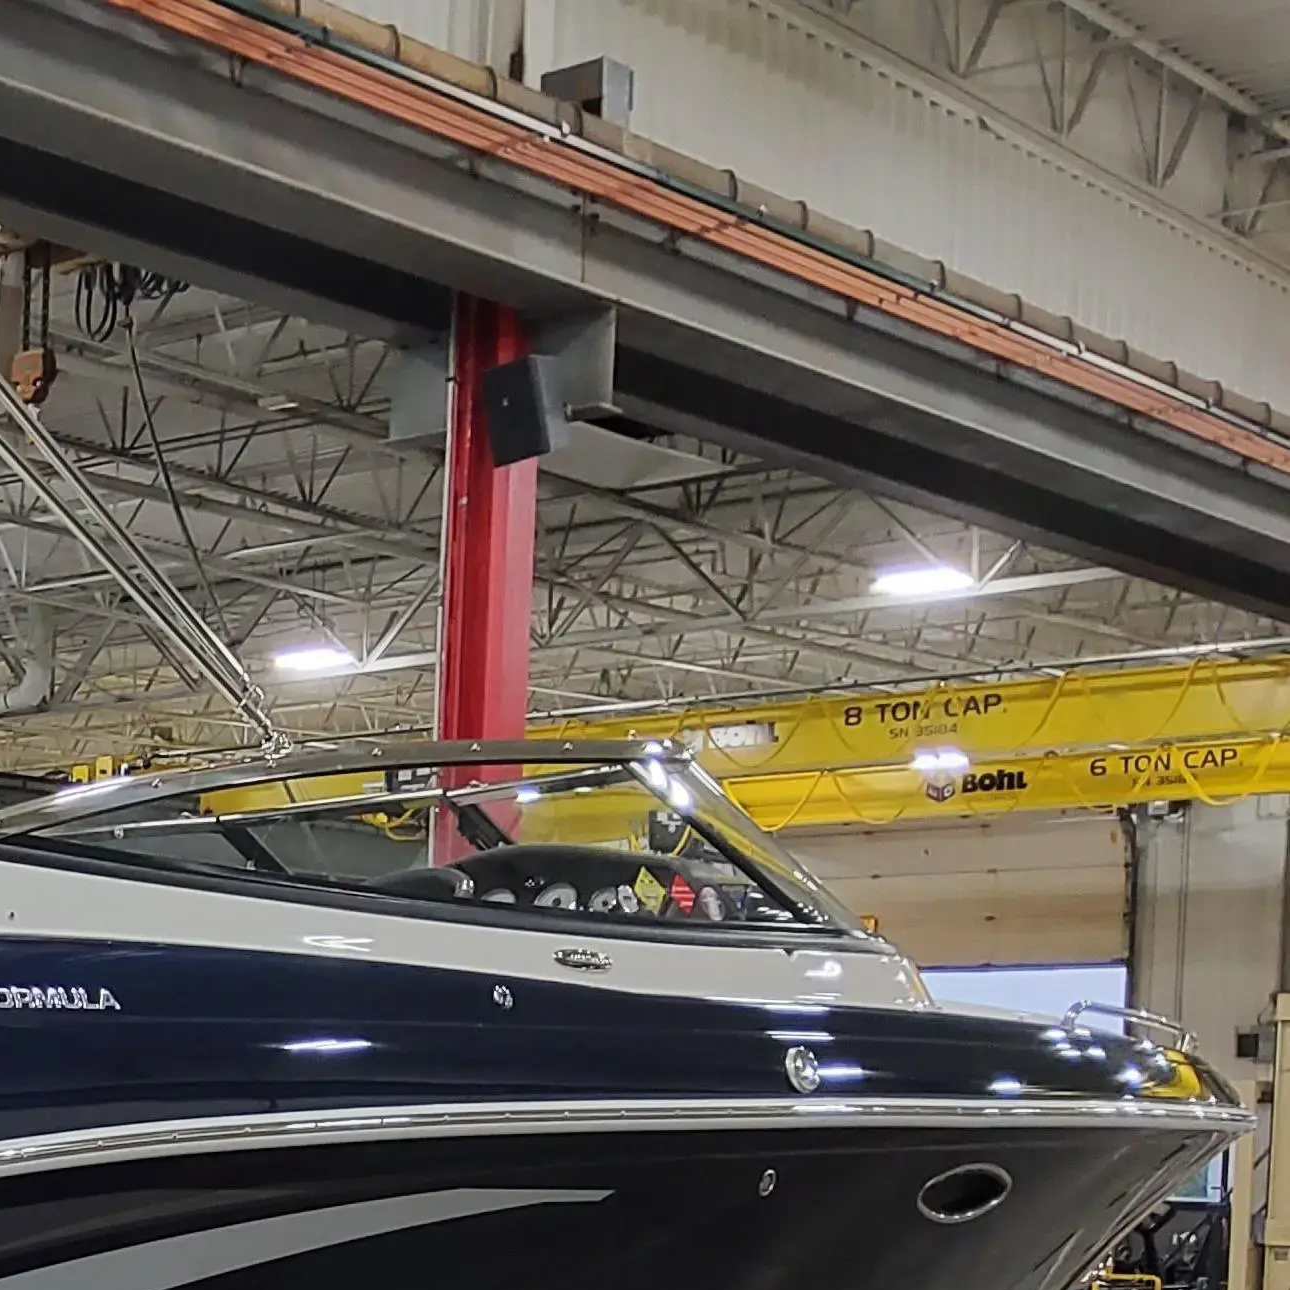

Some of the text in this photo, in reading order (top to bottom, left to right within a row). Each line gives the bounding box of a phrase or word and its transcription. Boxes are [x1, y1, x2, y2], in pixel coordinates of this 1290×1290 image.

[844, 706, 863, 726] 8
[875, 699, 931, 724] TON
[1090, 758, 1107, 776] 6
[1119, 752, 1171, 774] TON
[961, 769, 1028, 793] Bohl
